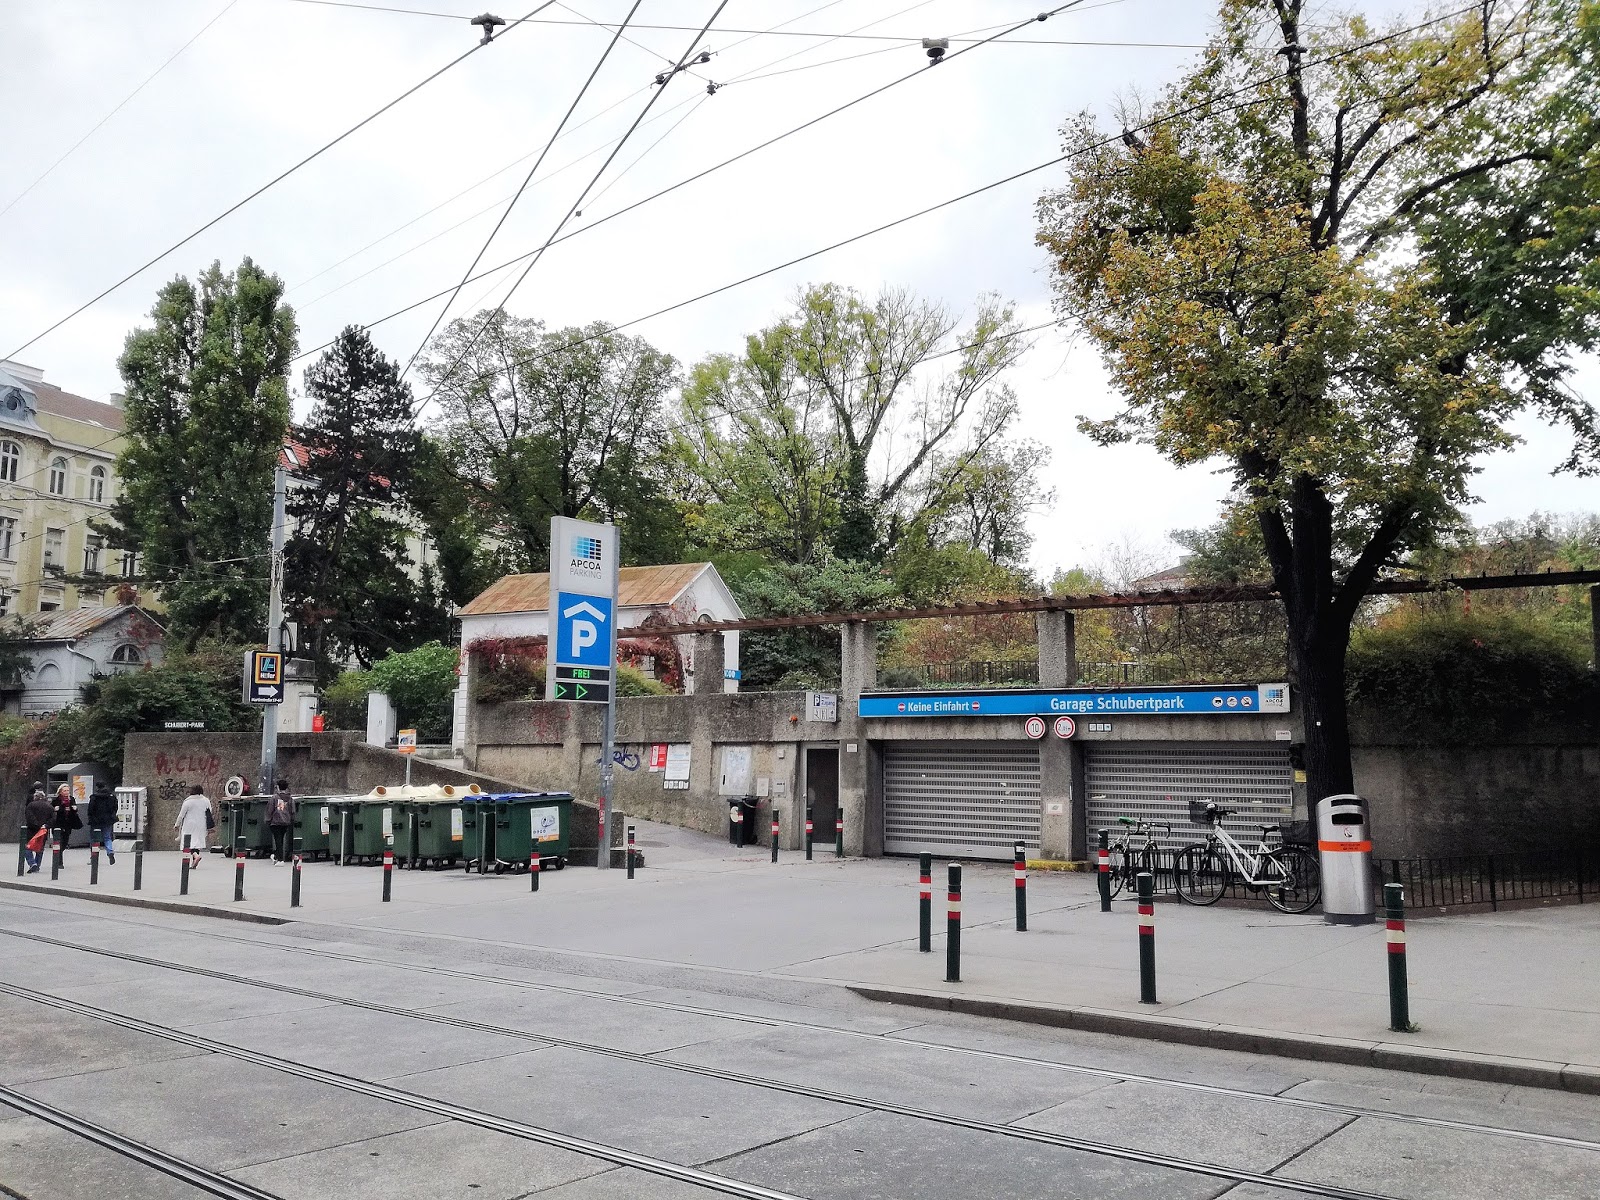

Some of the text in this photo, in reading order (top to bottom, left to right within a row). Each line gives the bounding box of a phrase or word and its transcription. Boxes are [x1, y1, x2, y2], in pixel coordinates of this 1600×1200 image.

[570, 559, 602, 571] APCOA
[569, 568, 602, 580] PARKING
[571, 619, 598, 658] P
[572, 669, 591, 679] FREI
[907, 700, 970, 712] Keine Einfahrt
[1050, 695, 1185, 713] Garage Schubertpark
[1031, 723, 1040, 733] 10
